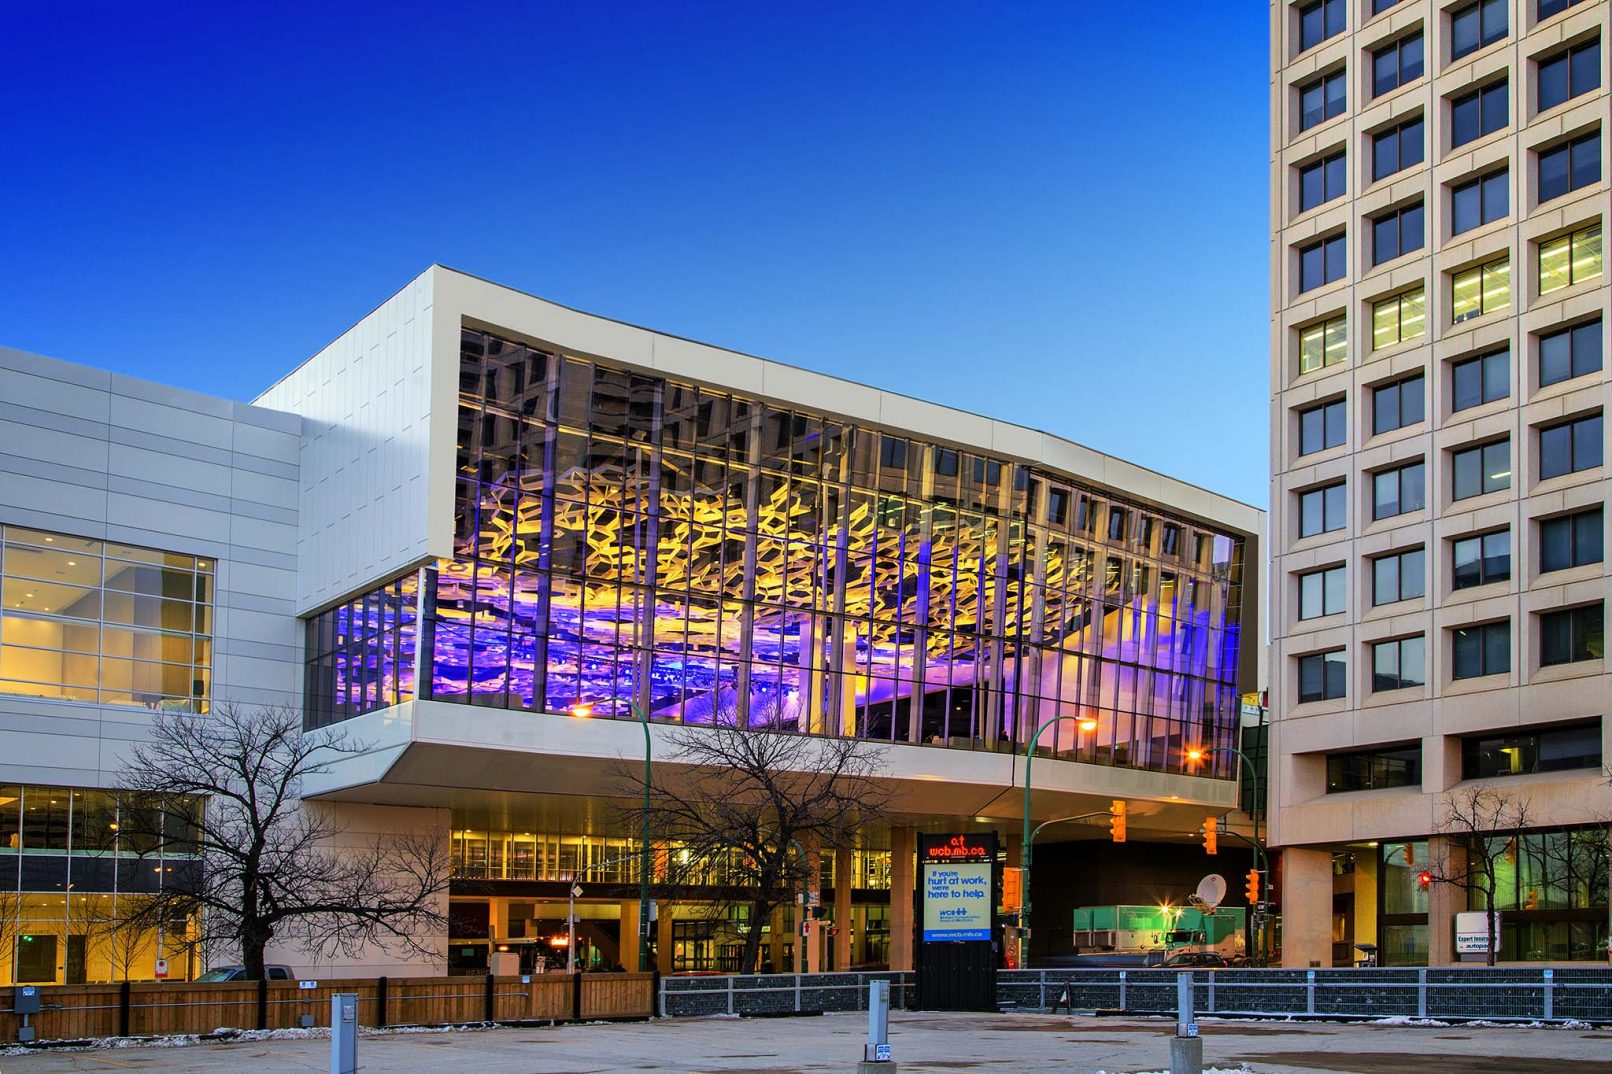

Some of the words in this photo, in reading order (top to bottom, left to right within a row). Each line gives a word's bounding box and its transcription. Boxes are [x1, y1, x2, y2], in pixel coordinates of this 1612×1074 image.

[951, 835, 965, 846] at
[929, 845, 985, 856] wcb.mb.ca
[928, 876, 947, 885] hurt
[948, 877, 959, 885] at
[961, 876, 987, 885] work,
[928, 890, 949, 898] here
[951, 890, 961, 898] to
